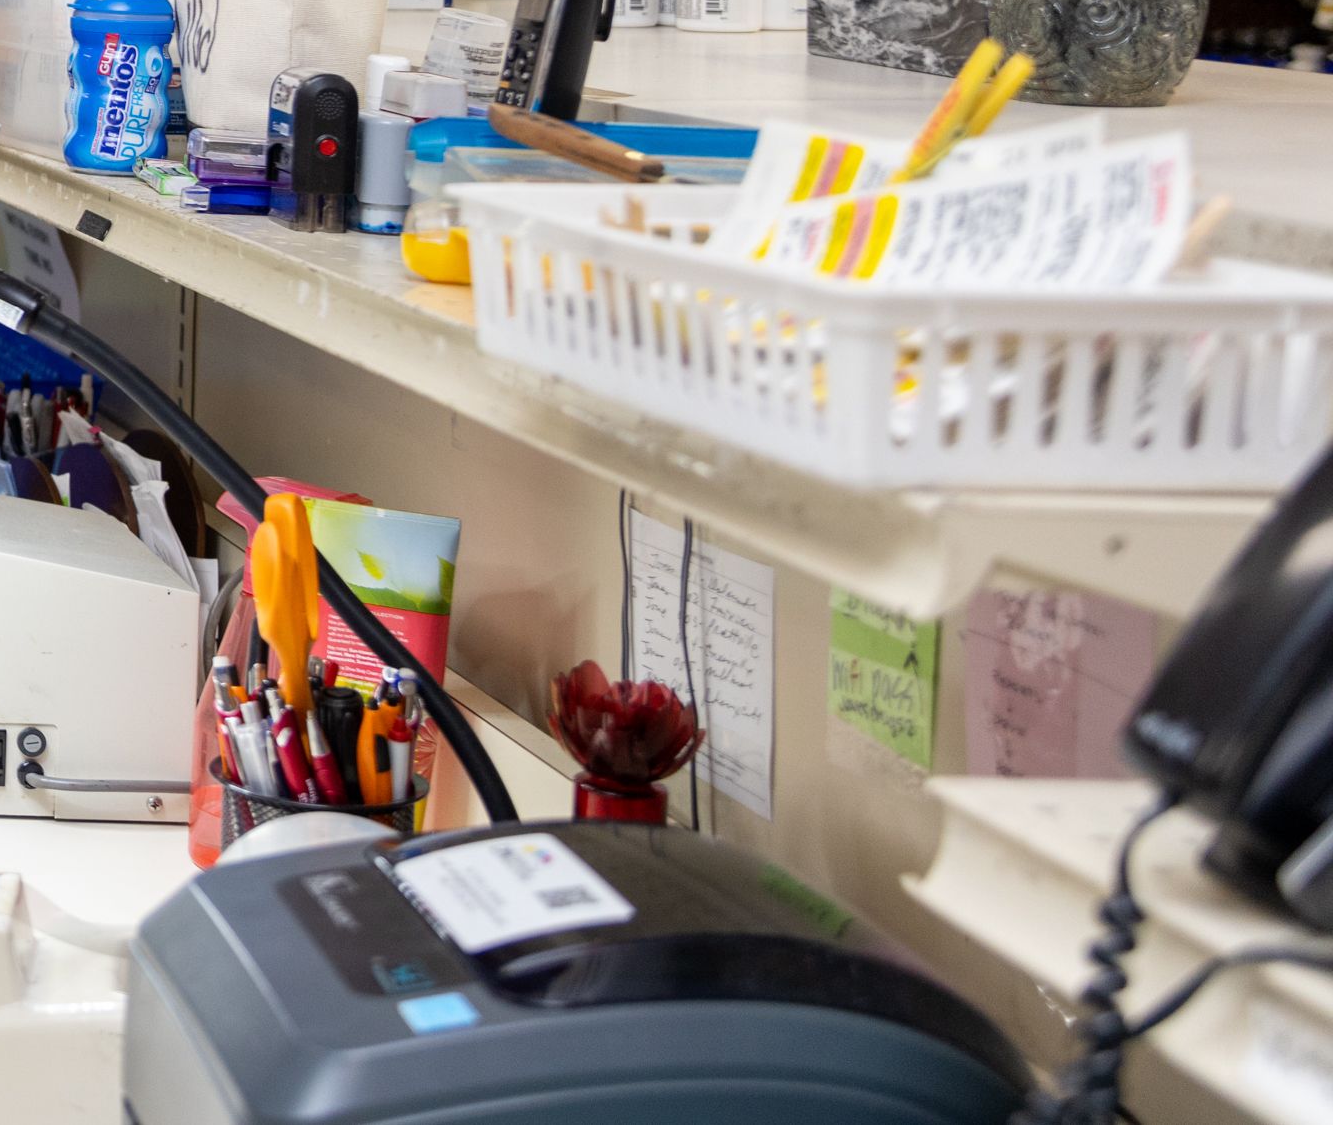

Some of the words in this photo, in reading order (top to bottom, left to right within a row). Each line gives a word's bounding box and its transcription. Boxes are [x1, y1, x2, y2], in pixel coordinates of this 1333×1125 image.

[98, 45, 137, 157] mentos
[133, 74, 149, 106] FRESH
[120, 108, 152, 158] PURE
